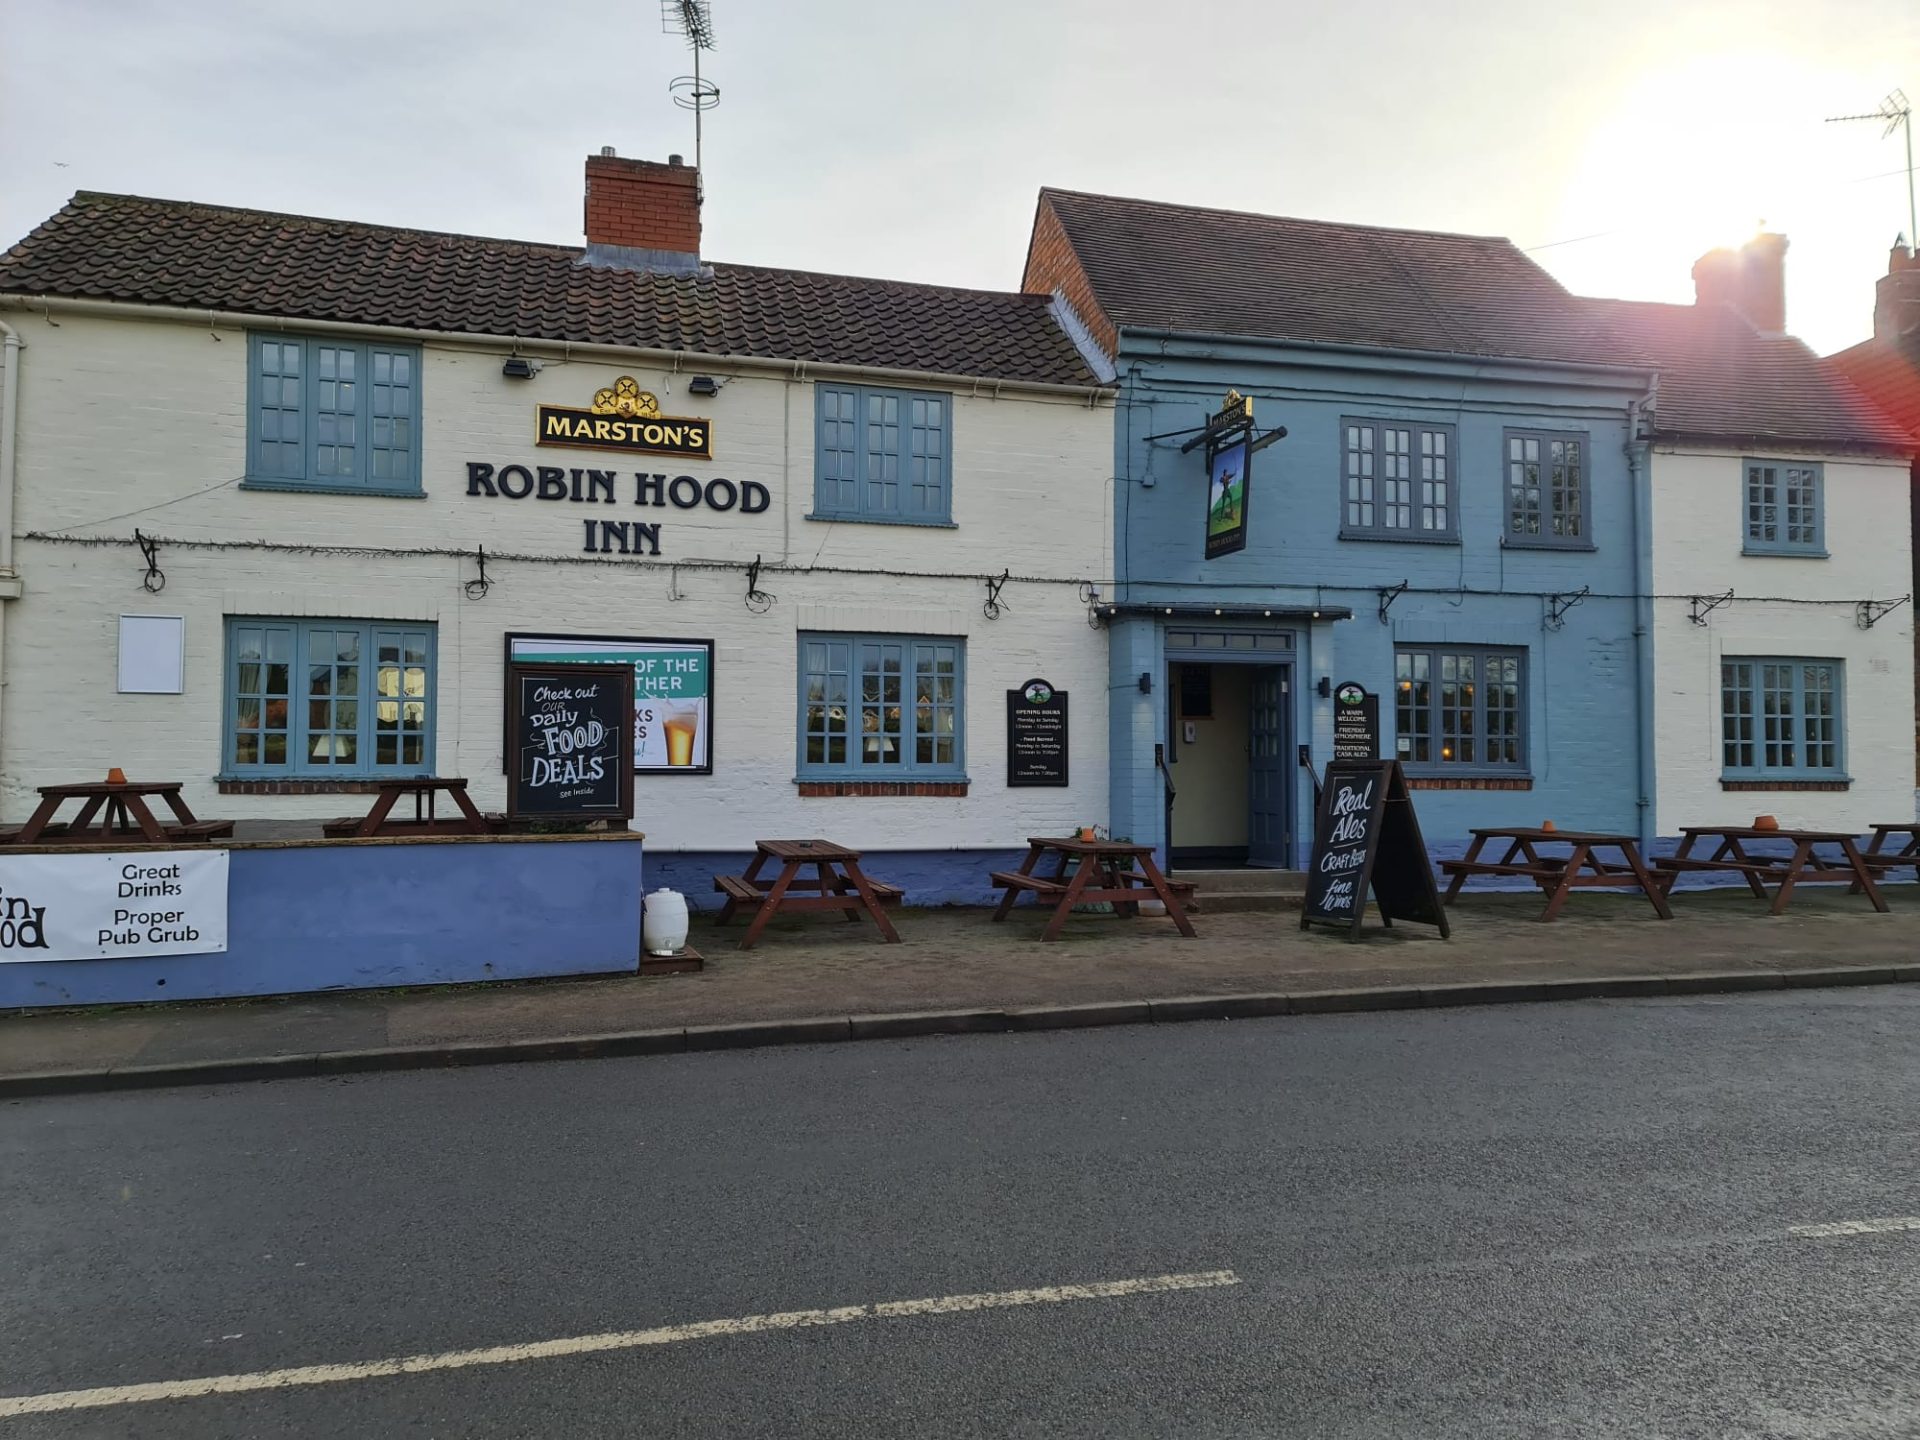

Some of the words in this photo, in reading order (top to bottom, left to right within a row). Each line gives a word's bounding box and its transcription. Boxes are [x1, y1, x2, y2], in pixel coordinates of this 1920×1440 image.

[546, 416, 703, 447] MARSTON'S
[466, 462, 616, 503] ROBIN
[635, 472, 770, 513] HOOD
[583, 519, 661, 555] INN
[634, 659, 657, 673] OF
[663, 658, 699, 673] THE
[533, 685, 573, 702] Check
[574, 684, 600, 698] out
[529, 710, 579, 728] Daily
[541, 720, 603, 755] FOOD
[529, 754, 604, 787] DEALS
[1332, 780, 1372, 815] Real
[1329, 813, 1367, 843] Ales
[122, 864, 181, 880] Great
[118, 881, 182, 898] Drinks
[114, 909, 185, 926] Proper
[98, 929, 141, 946] Pub
[147, 926, 199, 943] Grub
